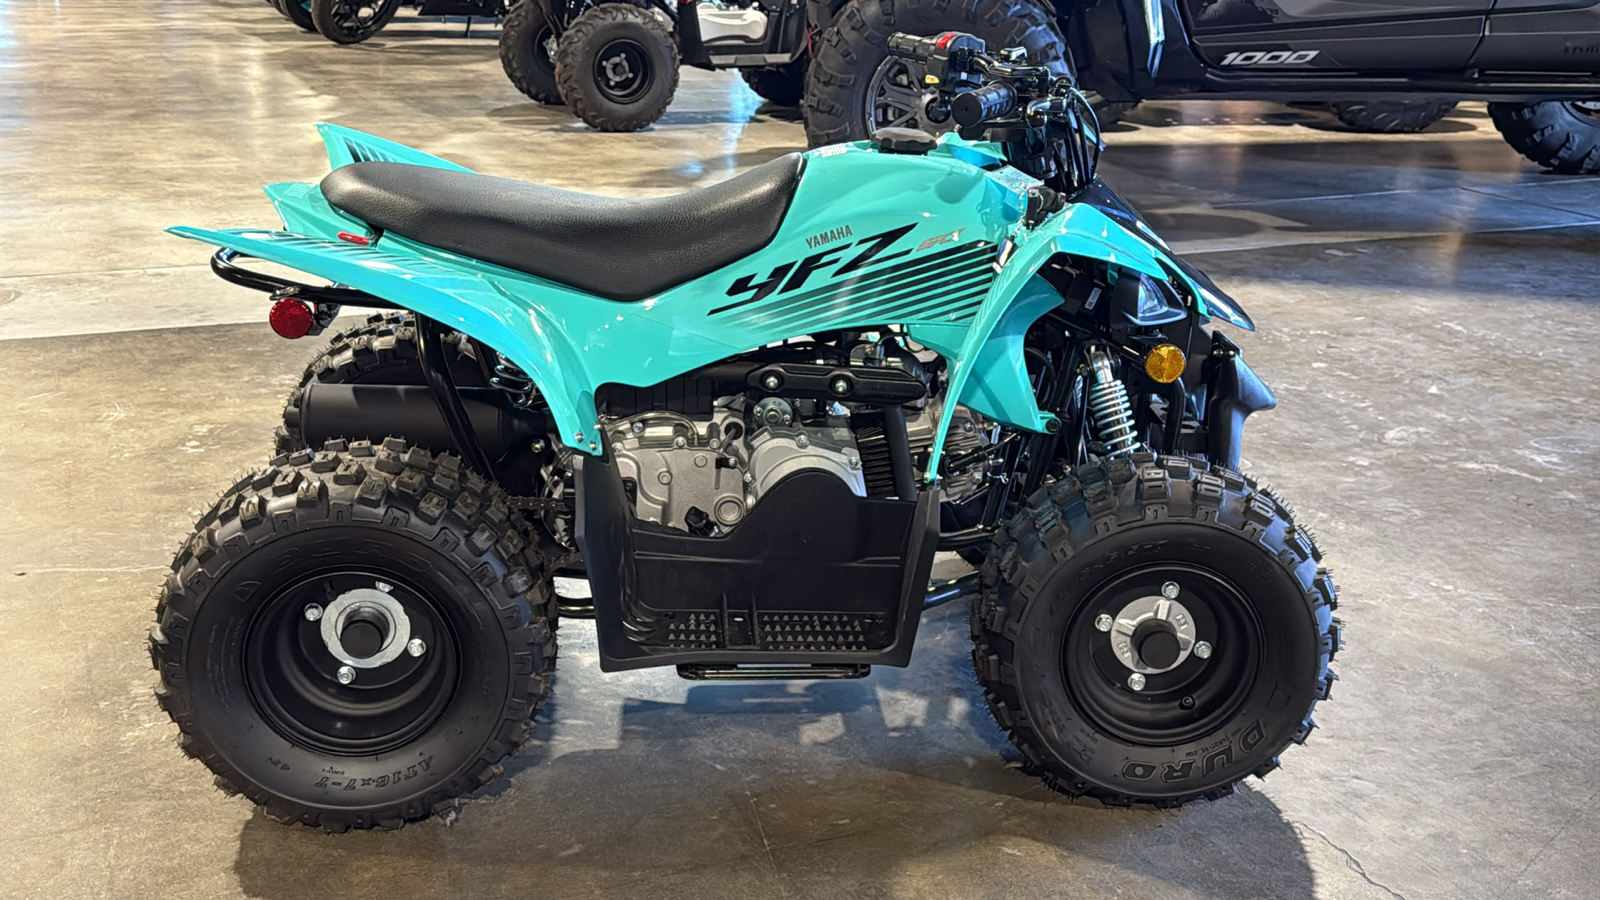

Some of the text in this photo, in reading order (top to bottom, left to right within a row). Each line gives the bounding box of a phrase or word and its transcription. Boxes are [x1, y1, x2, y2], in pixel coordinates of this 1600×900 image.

[1220, 50, 1320, 66] 1000
[805, 225, 853, 249] YAMAHA
[706, 222, 919, 316] YFZ
[1122, 719, 1266, 783] DURO
